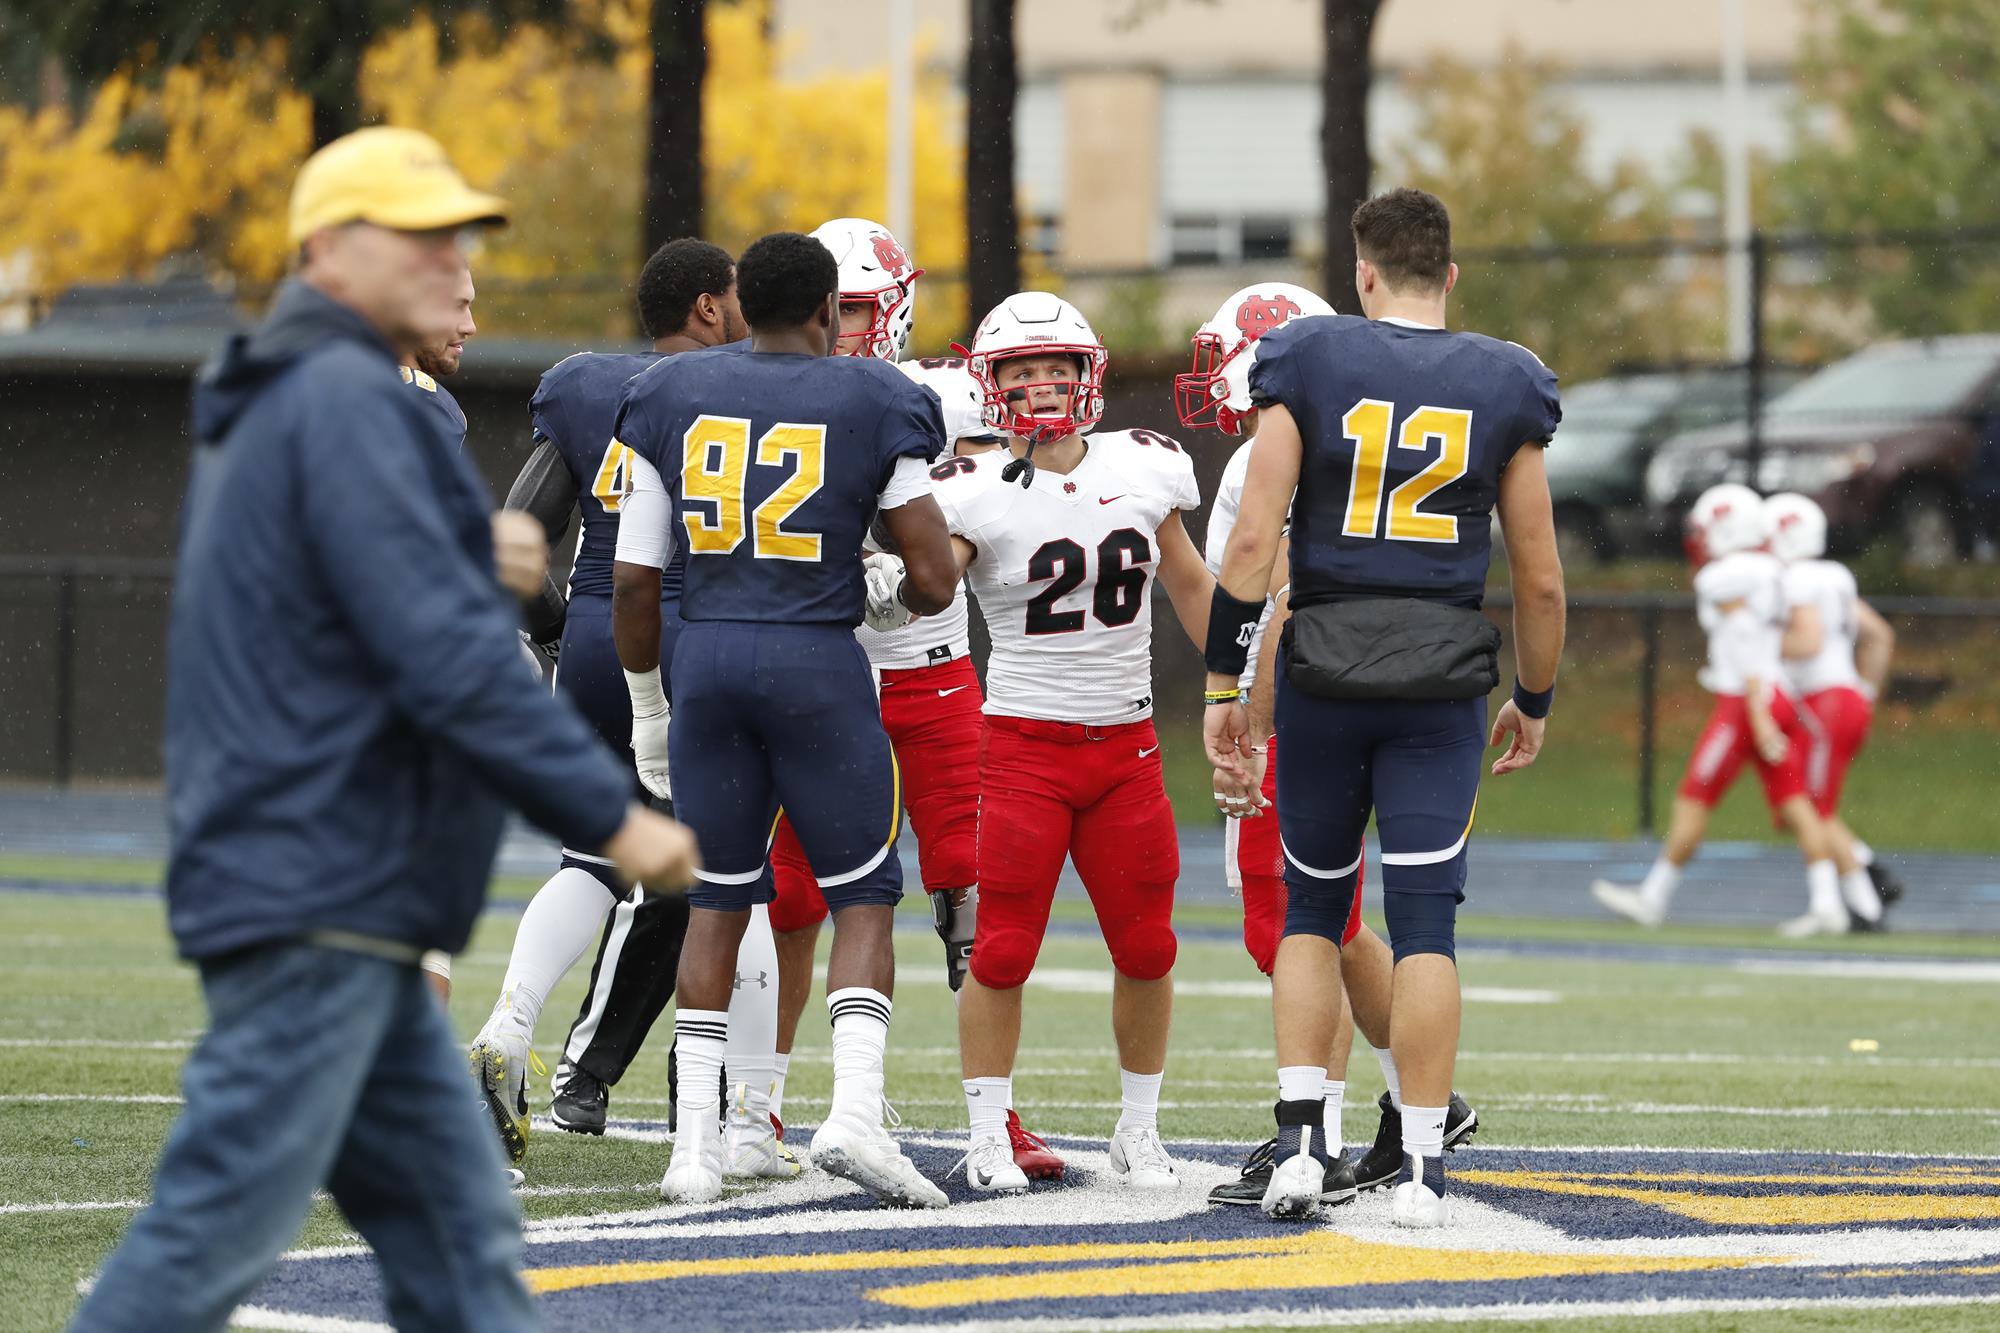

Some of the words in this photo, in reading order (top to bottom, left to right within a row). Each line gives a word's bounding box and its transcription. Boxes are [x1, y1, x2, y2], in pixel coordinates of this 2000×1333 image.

[681, 414, 828, 563] 92
[1342, 397, 1473, 544] 12
[1024, 528, 1152, 637] 26
